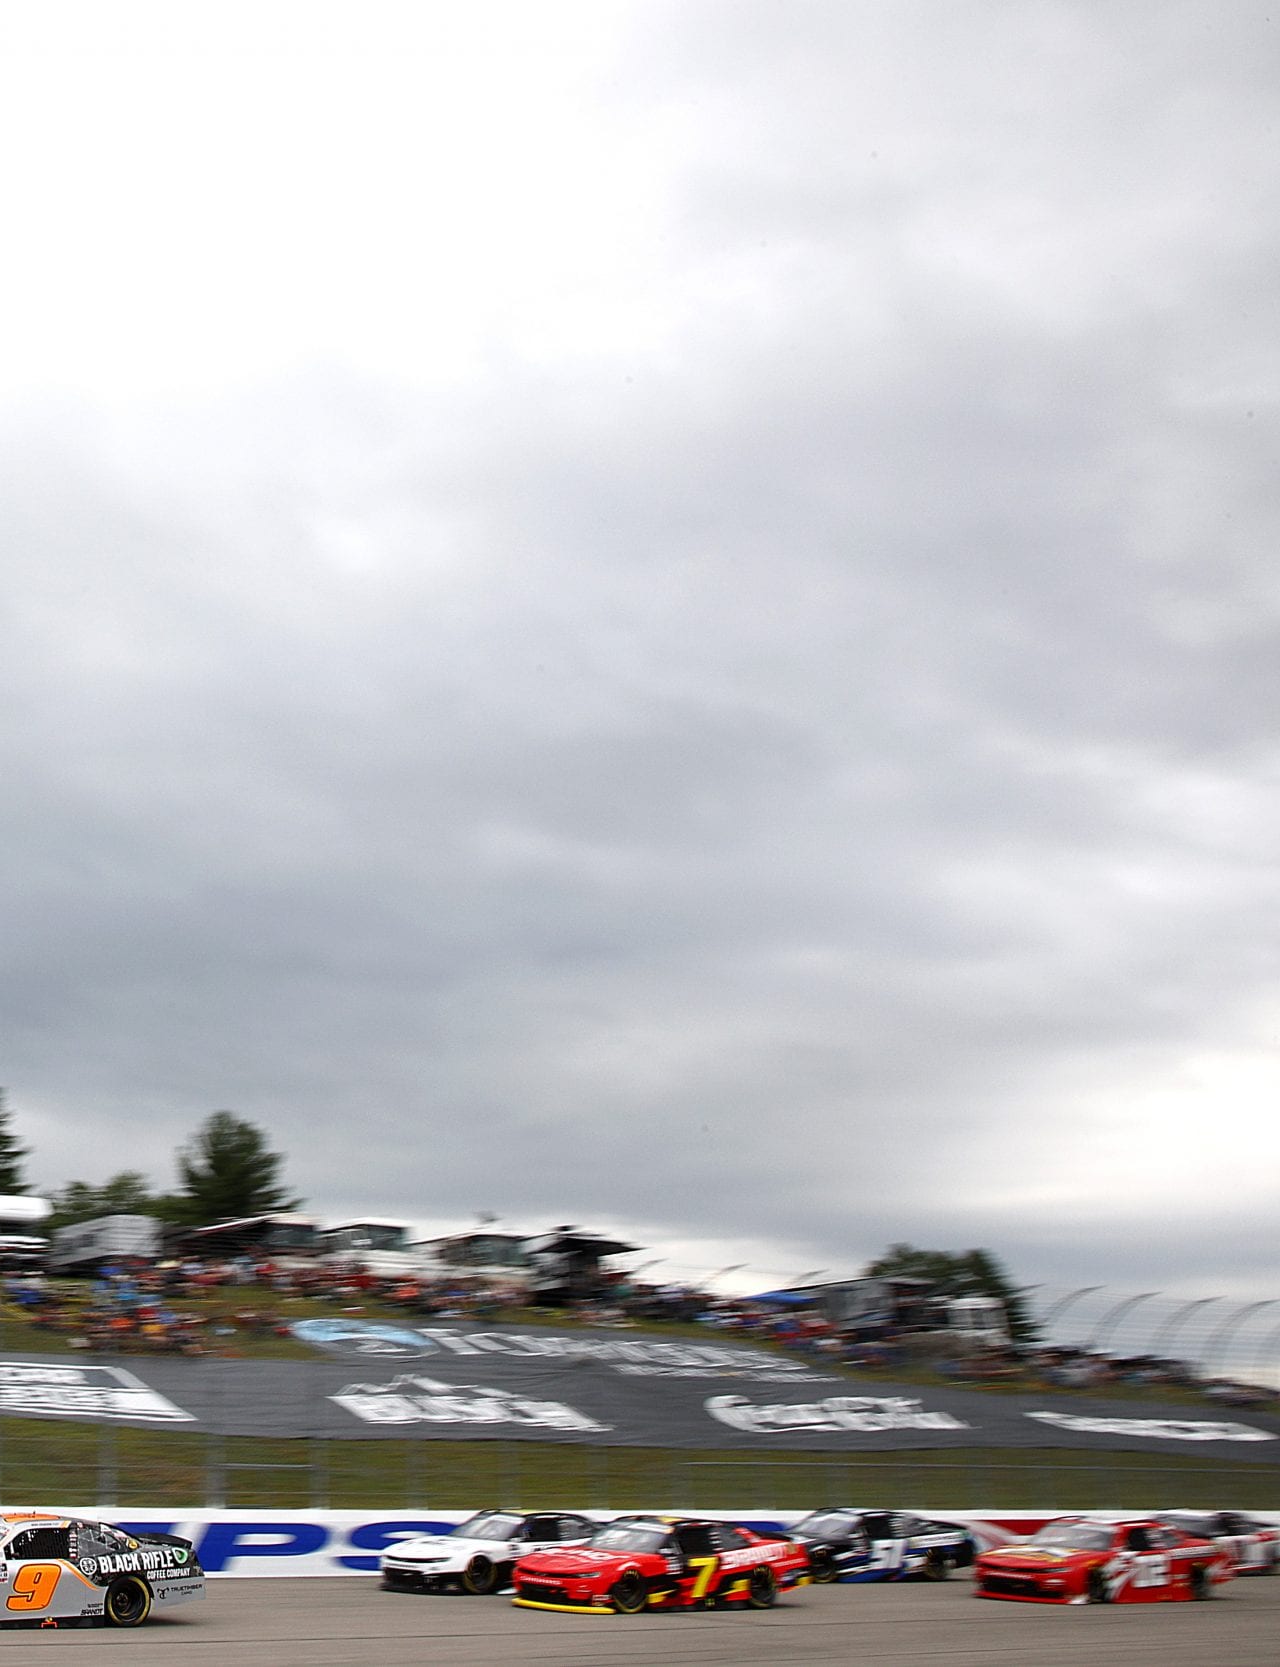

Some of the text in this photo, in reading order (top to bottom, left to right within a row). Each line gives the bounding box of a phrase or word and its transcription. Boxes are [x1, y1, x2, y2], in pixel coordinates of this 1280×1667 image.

[98, 1553, 141, 1574] BLACK
[141, 1550, 174, 1570] RIFLE
[147, 1567, 191, 1580] COFFEE COMPANY
[688, 1557, 718, 1598] 7
[6, 1563, 61, 1611] 9
